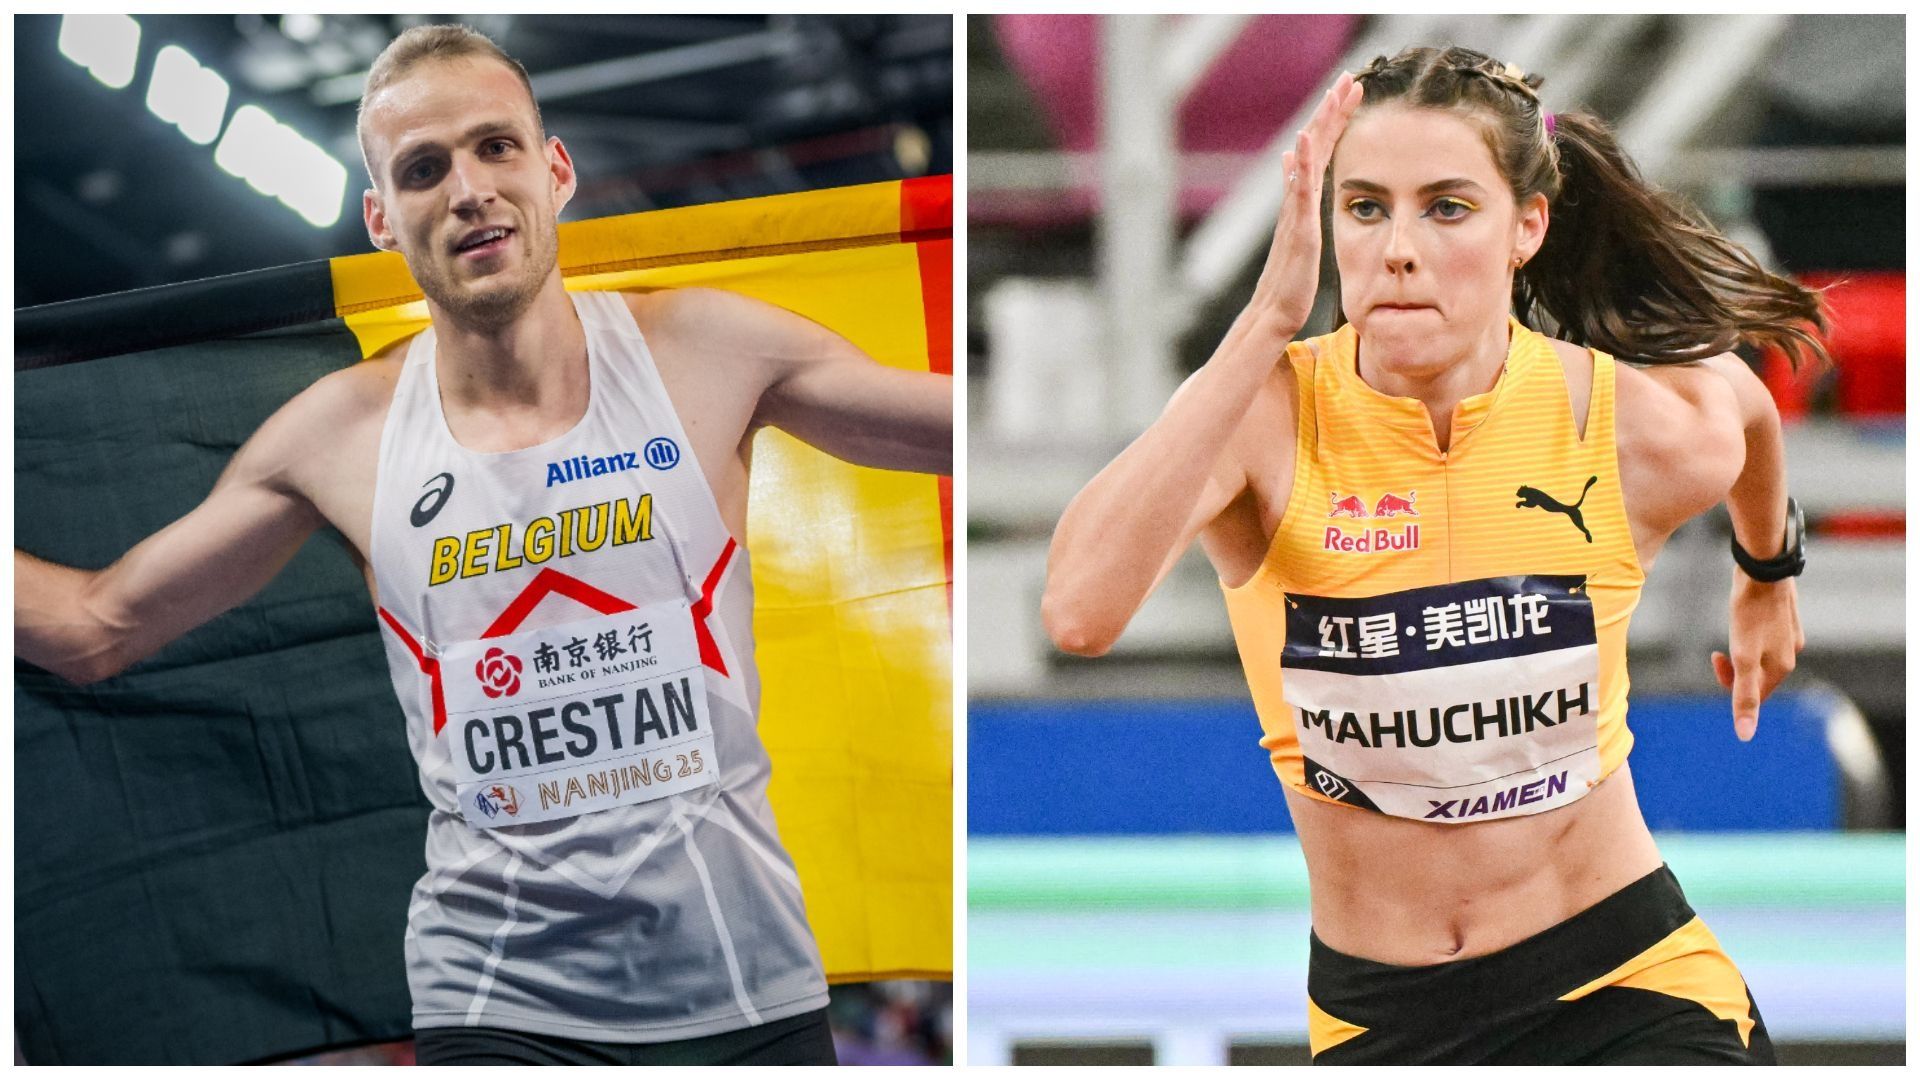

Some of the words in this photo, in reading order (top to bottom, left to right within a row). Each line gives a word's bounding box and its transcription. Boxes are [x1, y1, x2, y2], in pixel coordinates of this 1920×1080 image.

[546, 451, 639, 487] Allianz
[429, 493, 653, 586] BELGIUM
[1324, 527, 1370, 552] Red
[1374, 525, 1419, 551] Bull
[1318, 593, 1552, 659] 红星·美凯龙
[538, 672, 576, 689] BANK
[580, 668, 597, 681] OF
[602, 656, 658, 676] NANJING
[464, 677, 698, 775] CRESTAN
[1302, 682, 1589, 748] MAHUCHIKH
[1424, 770, 1568, 819] XIAMEN
